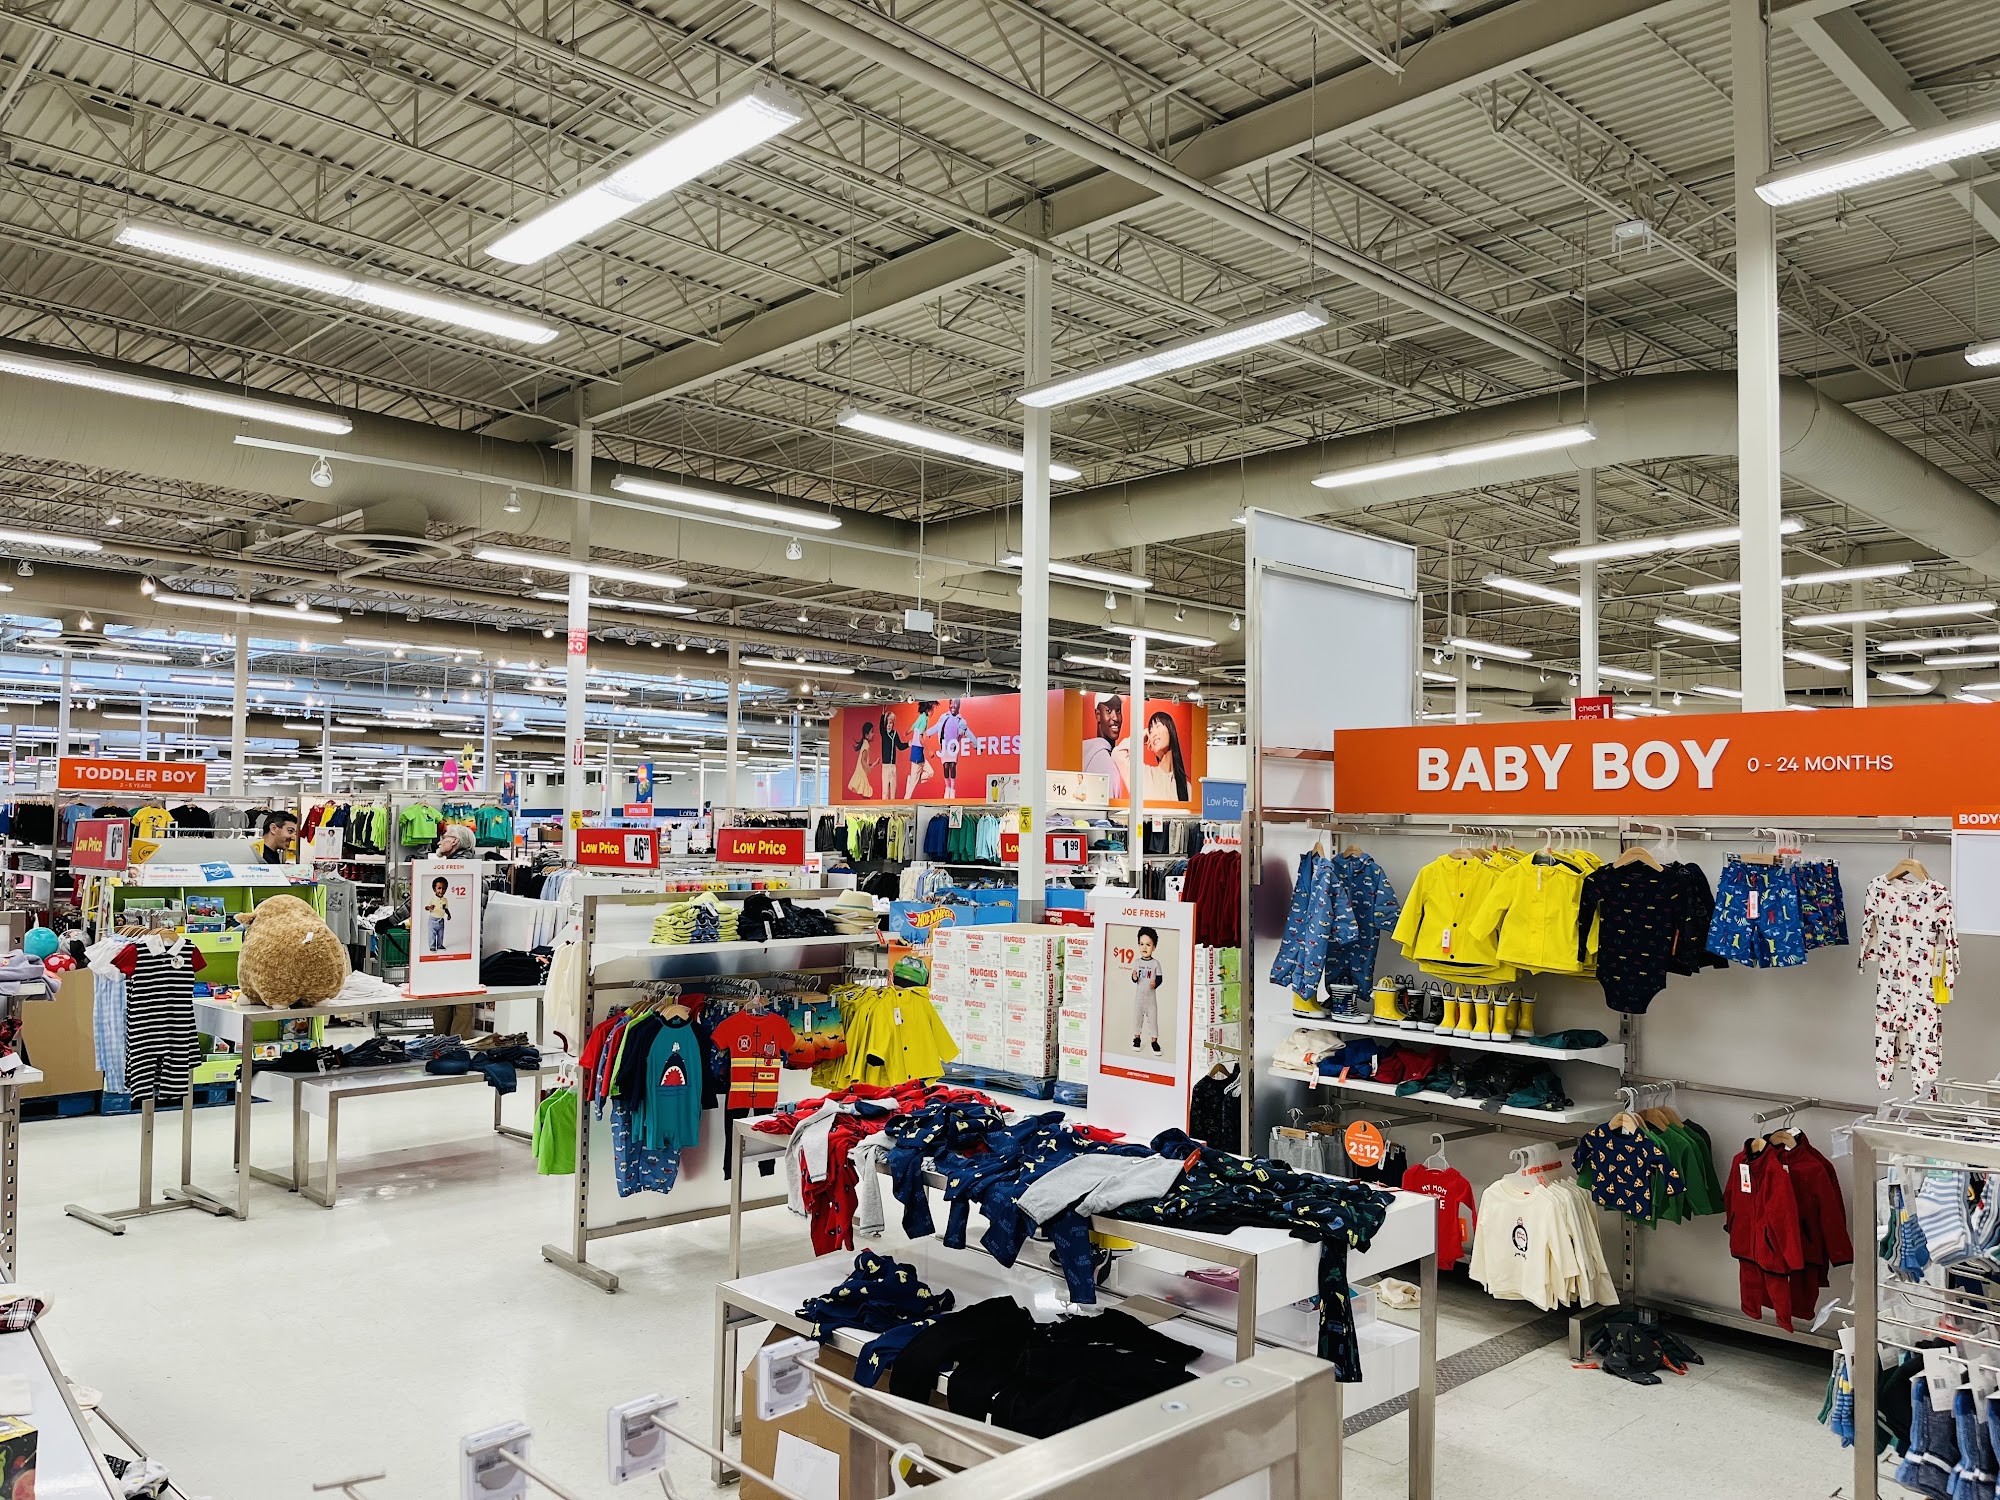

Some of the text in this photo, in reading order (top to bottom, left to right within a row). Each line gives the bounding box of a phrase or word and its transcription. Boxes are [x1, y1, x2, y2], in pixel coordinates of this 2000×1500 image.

[1578, 704, 1601, 713] check
[936, 737, 971, 758] JOE
[1417, 743, 1573, 791] BABY
[1592, 738, 1730, 790] BOY
[1747, 757, 1760, 772] 0
[1776, 756, 1799, 772] 24
[1804, 754, 1894, 771] MONTHS
[74, 766, 198, 783] TODDLER BOY
[1052, 784, 1067, 796] $16
[1206, 797, 1238, 807] Low Price
[76, 836, 87, 851] Low
[88, 838, 103, 853] Price
[581, 841, 597, 854] Low
[599, 842, 620, 854] Price
[733, 840, 787, 856] Low Price
[452, 886, 466, 896] $12
[1122, 908, 1166, 918] JOE FRESH
[1004, 936, 1026, 944] HUGGIES
[1067, 938, 1088, 946] HUGGIES
[1113, 946, 1134, 964] $19
[970, 967, 998, 978] HUGGIES
[1005, 970, 1028, 978] HUGGIES
[1062, 1009, 1087, 1019] HUGGIES
[1062, 1046, 1087, 1056] HUGGIES
[1348, 1141, 1358, 1156] 2
[1432, 1184, 1448, 1195] MOM
